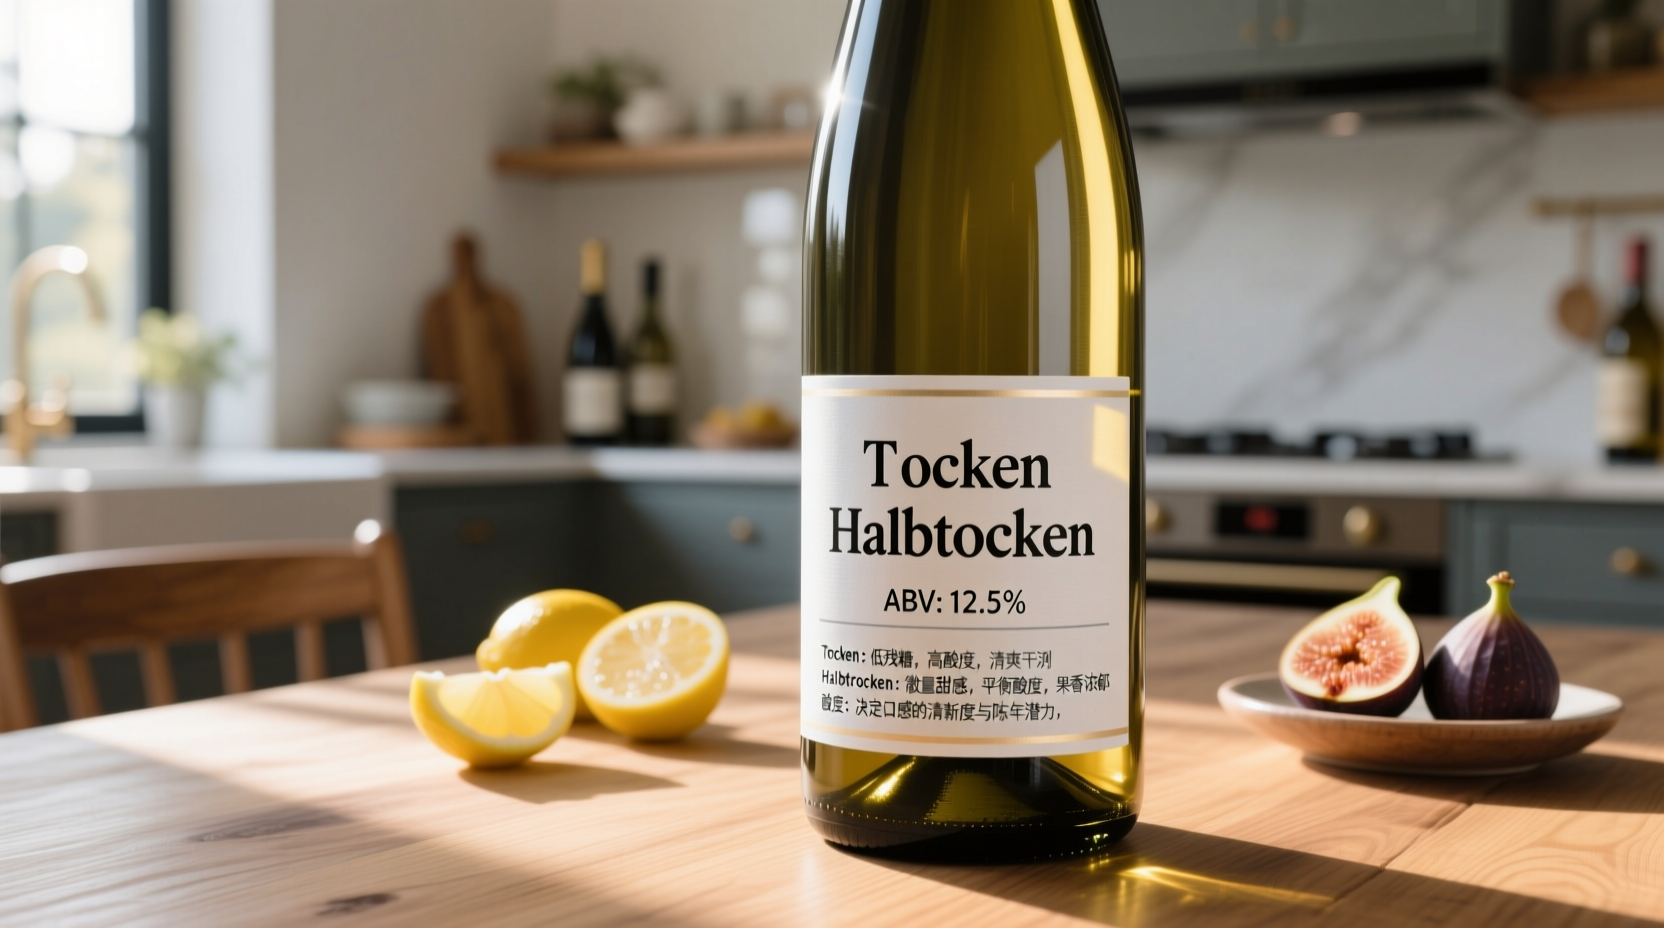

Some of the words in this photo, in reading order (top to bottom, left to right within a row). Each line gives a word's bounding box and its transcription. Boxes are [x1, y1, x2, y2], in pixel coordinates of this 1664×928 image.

[864, 438, 1051, 489] Tocken
[829, 506, 1095, 558] Halbtocken
[884, 588, 942, 613] ABV:
[950, 588, 1026, 614] 12.5%
